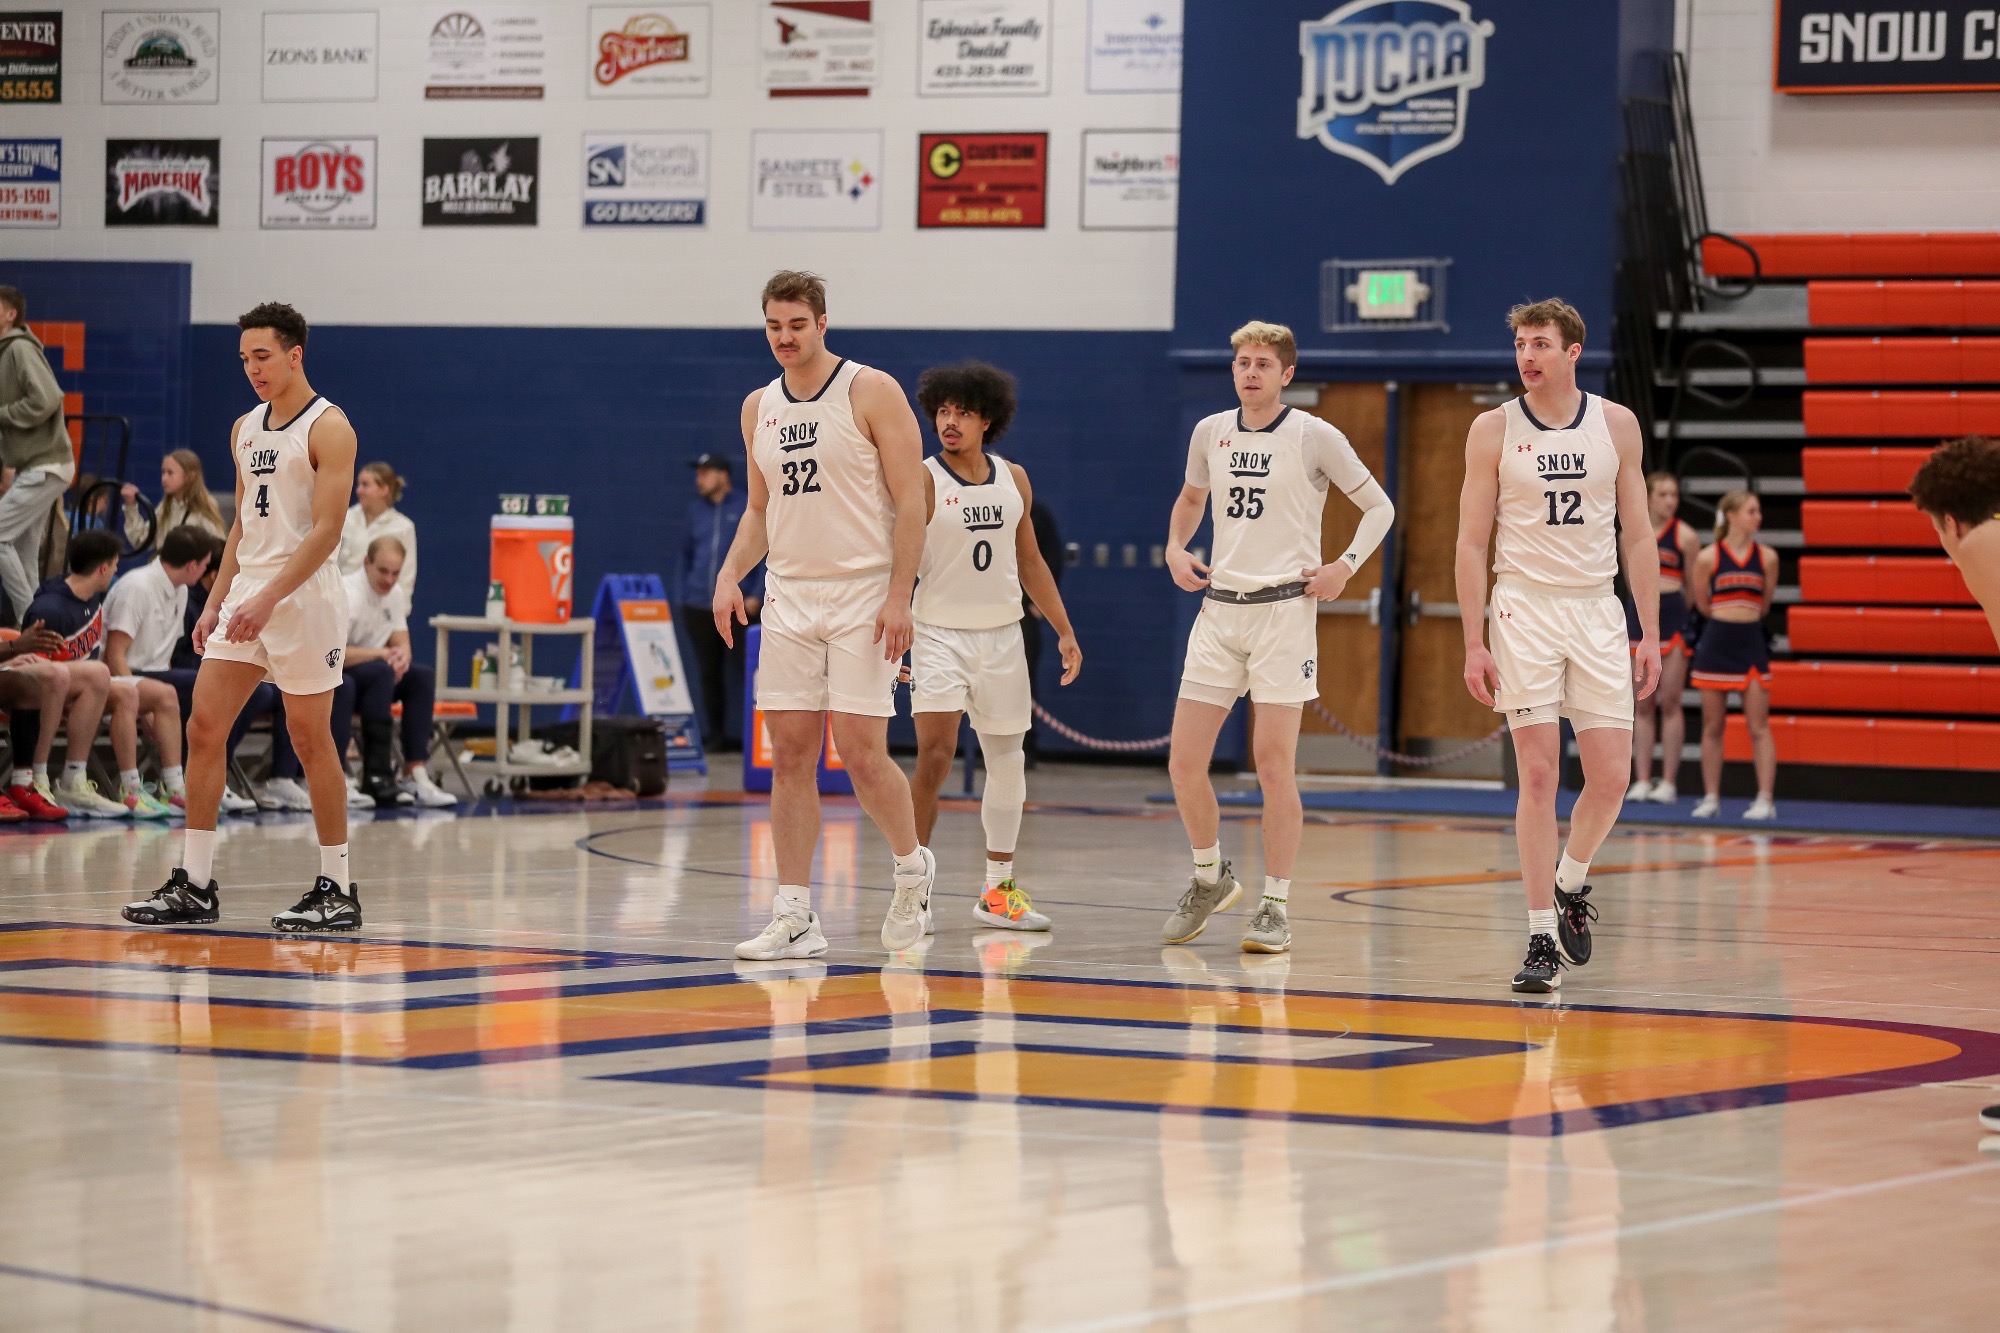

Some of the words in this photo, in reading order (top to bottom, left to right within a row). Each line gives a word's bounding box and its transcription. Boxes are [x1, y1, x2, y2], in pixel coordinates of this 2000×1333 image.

[0, 21, 57, 47] ENTER
[1799, 11, 1948, 63] SNOW
[1963, 10, 2000, 60] C
[266, 47, 318, 65] ZIONS
[322, 47, 371, 65] BANK
[1305, 26, 1477, 121] NJCAA
[0, 80, 55, 100] 5555
[17, 143, 59, 172] TOWING
[759, 159, 842, 176] SANPETE
[124, 171, 203, 206] MAVERIK
[423, 171, 535, 204] BARCLAY
[773, 182, 826, 199] STEEL
[592, 202, 618, 223] GO
[1368, 274, 1405, 305] EXIT
[780, 422, 819, 444] SNOW
[250, 449, 280, 468] SNOW
[1229, 451, 1273, 470] SNOW
[1536, 453, 1586, 472] SNOW
[781, 458, 822, 496] 32
[254, 484, 270, 518] 4
[962, 505, 1004, 524] SNOW
[1226, 486, 1267, 520] 35
[1543, 490, 1585, 526] 12
[972, 539, 993, 572] 0
